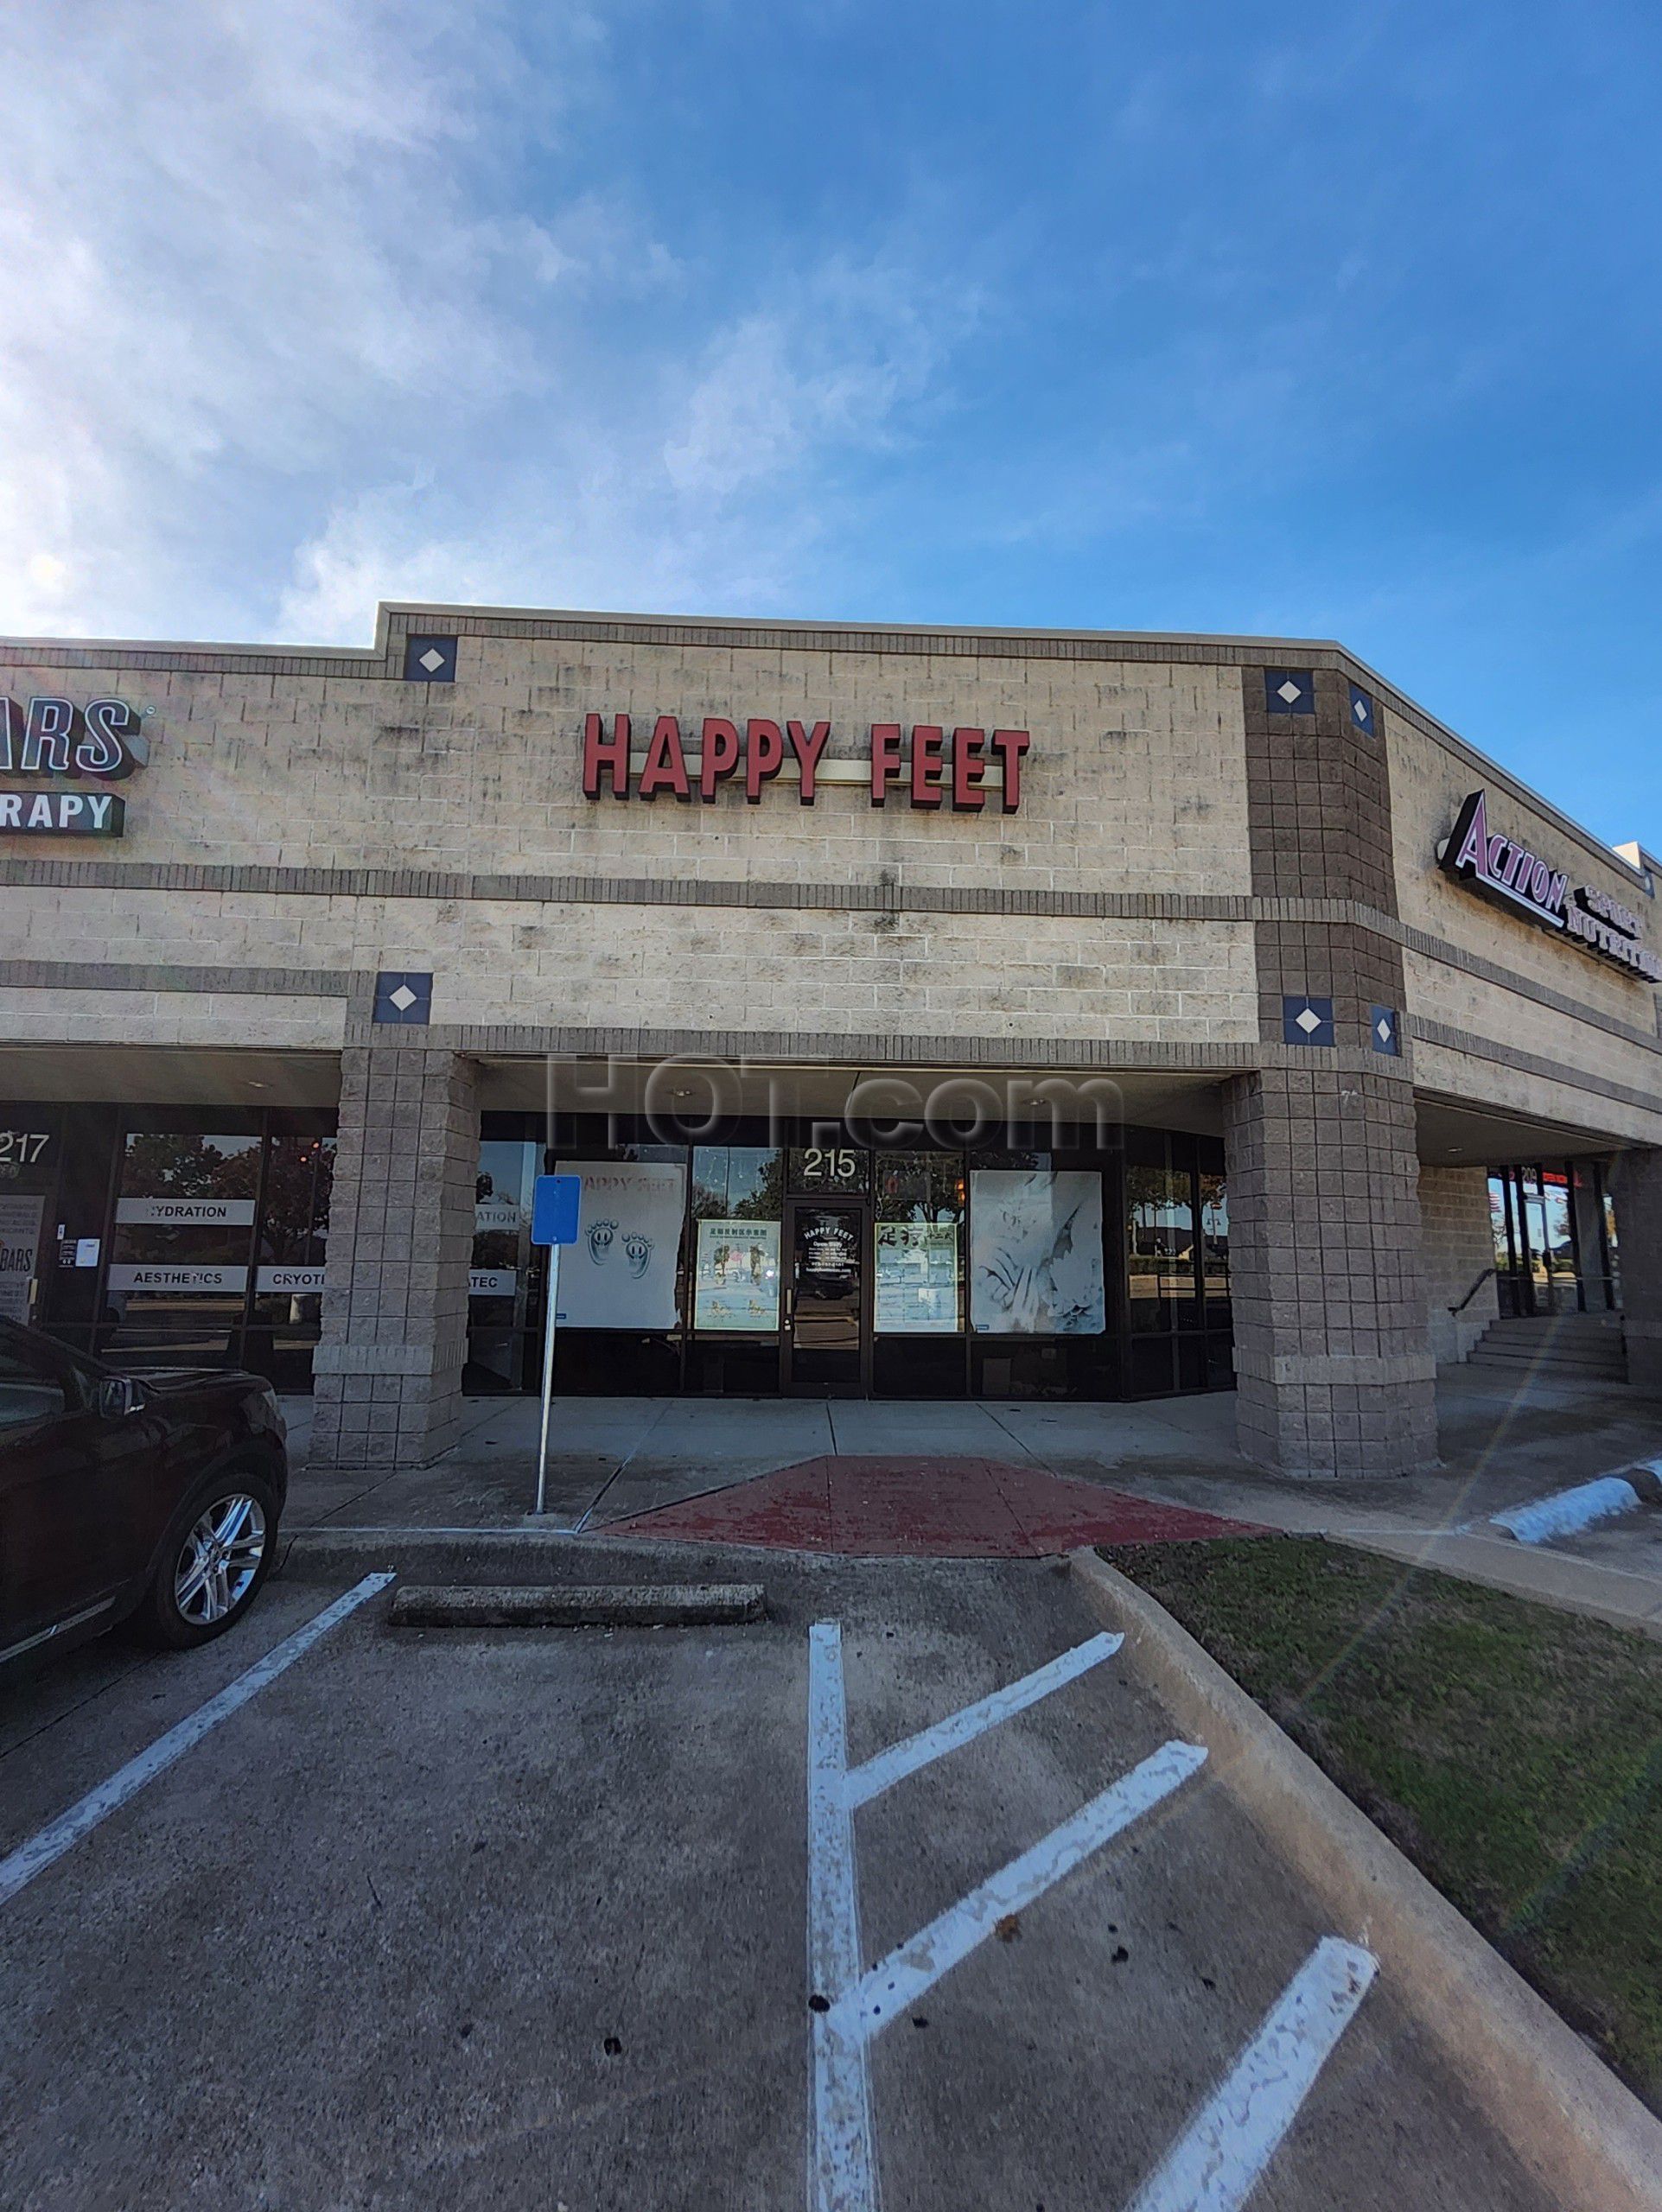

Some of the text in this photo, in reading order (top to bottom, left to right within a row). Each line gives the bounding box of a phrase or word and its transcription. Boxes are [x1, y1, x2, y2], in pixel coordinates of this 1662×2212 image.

[0, 697, 137, 778] RS
[583, 713, 1030, 813] HAPPY FEET
[0, 794, 111, 829] RAPY
[0, 1132, 49, 1162] 217
[804, 1147, 856, 1177] 215
[804, 1227, 854, 1241] HAPPY FEET
[468, 1276, 499, 1288] TEC
